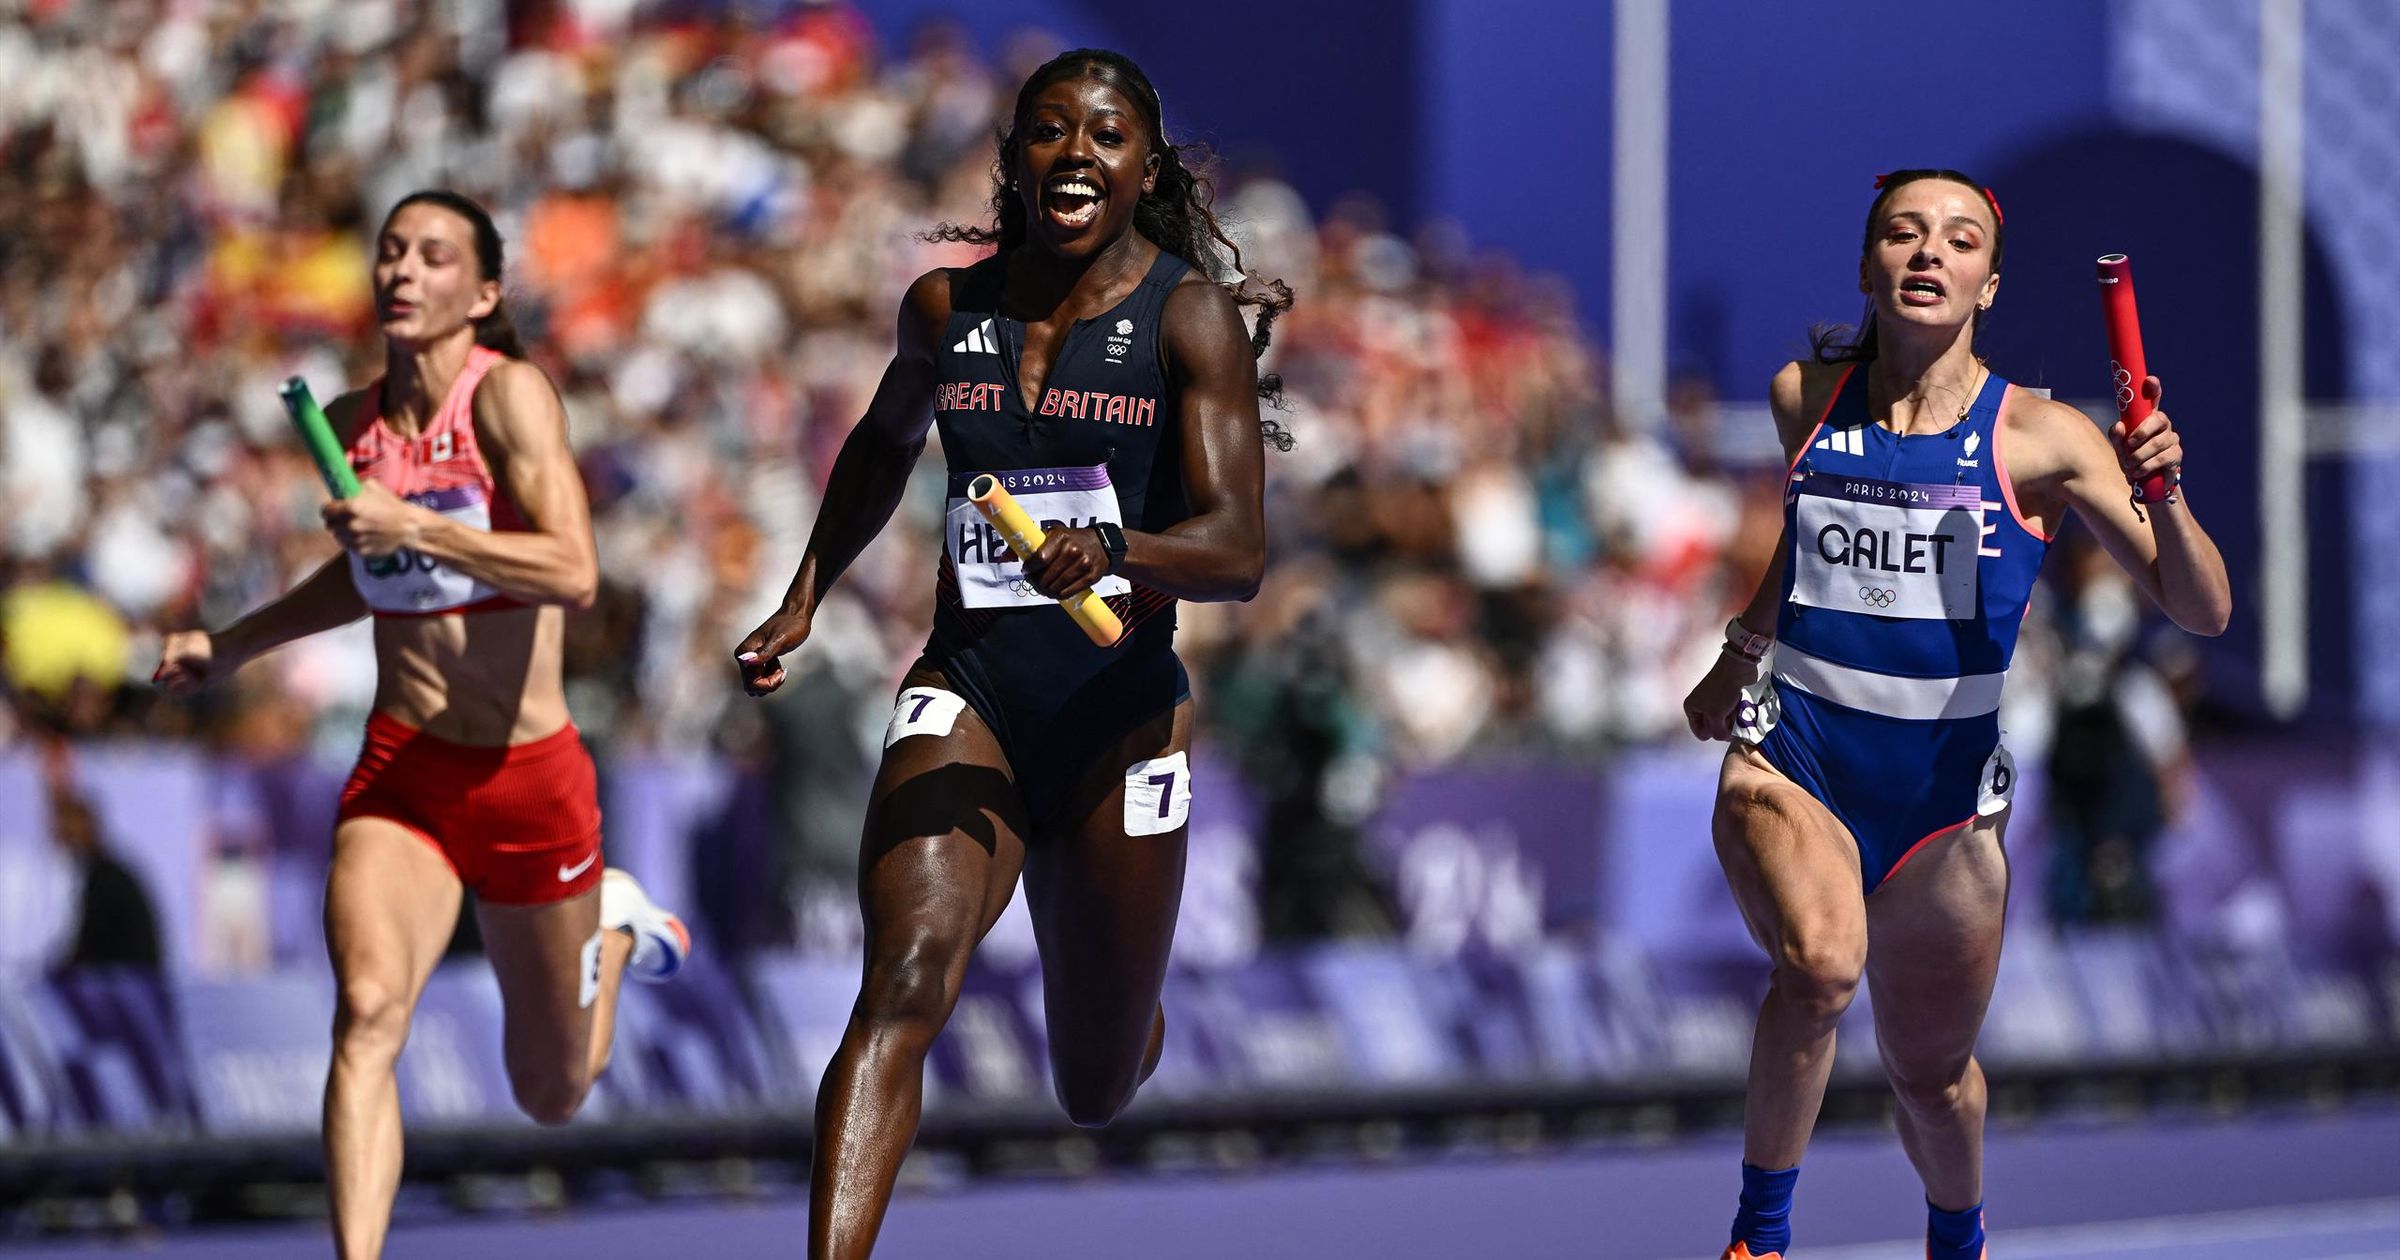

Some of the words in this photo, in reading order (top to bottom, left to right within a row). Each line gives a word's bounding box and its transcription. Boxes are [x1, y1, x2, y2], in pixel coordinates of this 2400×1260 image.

[935, 382, 1005, 412] GREAT
[1040, 387, 1156, 427] BRITAIN
[1957, 457, 1979, 468] FRANCE
[1022, 473, 1066, 487] 2024
[1845, 482, 1884, 498] PARIS
[1889, 487, 1929, 502] 2024
[1817, 523, 1955, 575] GALET
[907, 694, 936, 724] 7
[1148, 771, 1175, 818] 7
